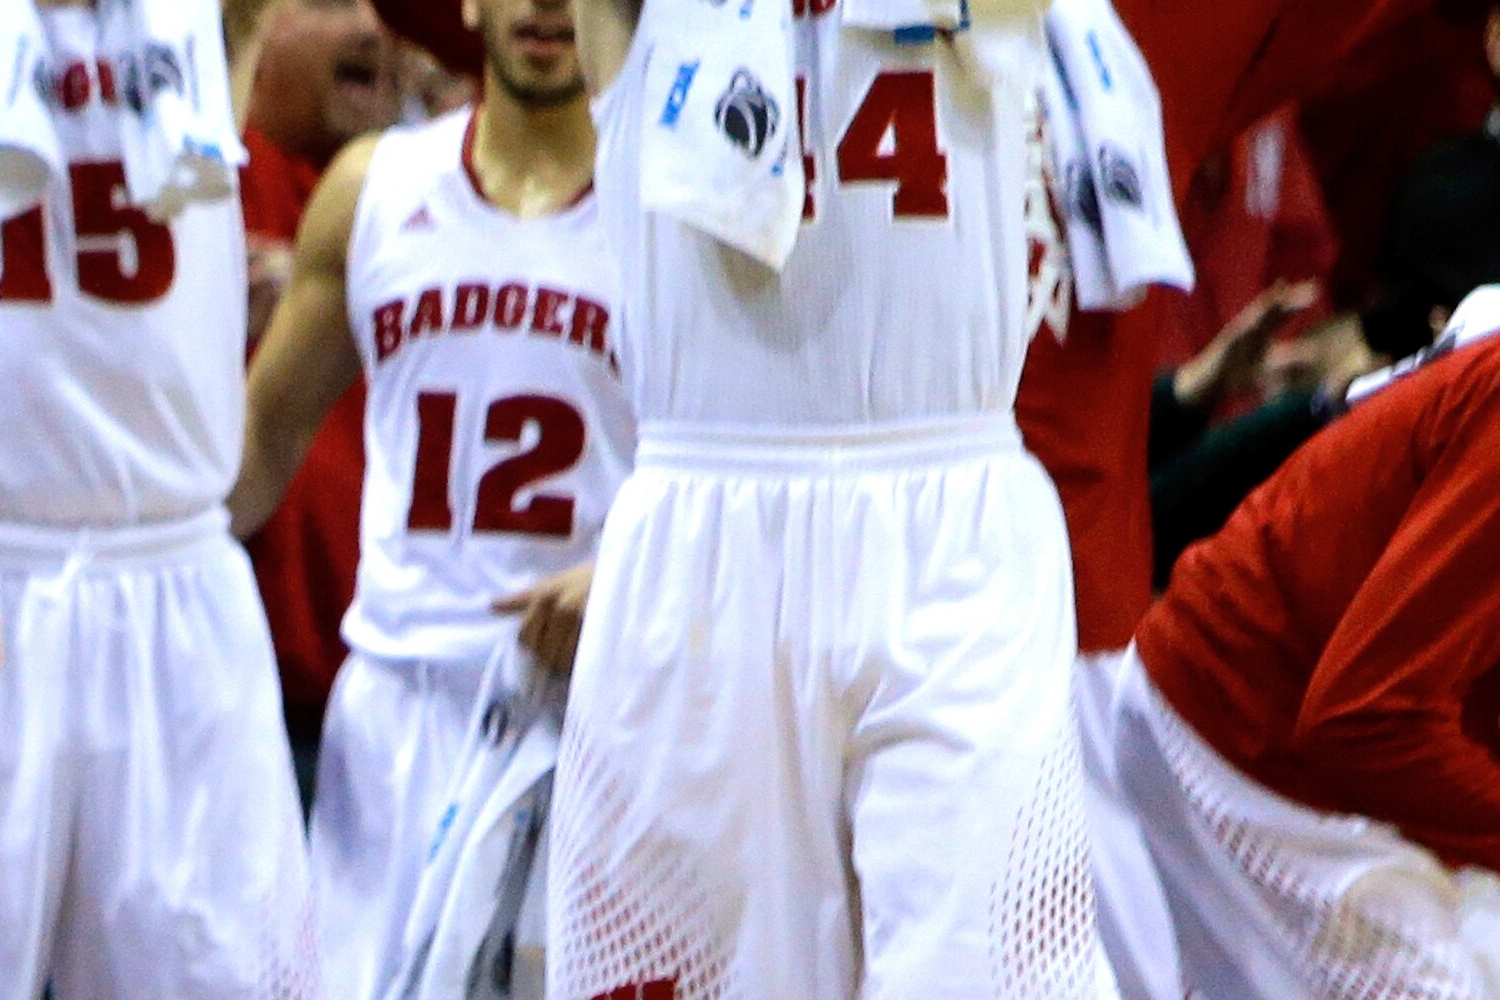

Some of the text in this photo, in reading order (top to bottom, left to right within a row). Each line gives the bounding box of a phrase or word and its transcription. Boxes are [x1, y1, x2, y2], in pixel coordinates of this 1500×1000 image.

[796, 69, 950, 222] 4
[372, 282, 620, 372] BADGER
[407, 392, 586, 537] 12
